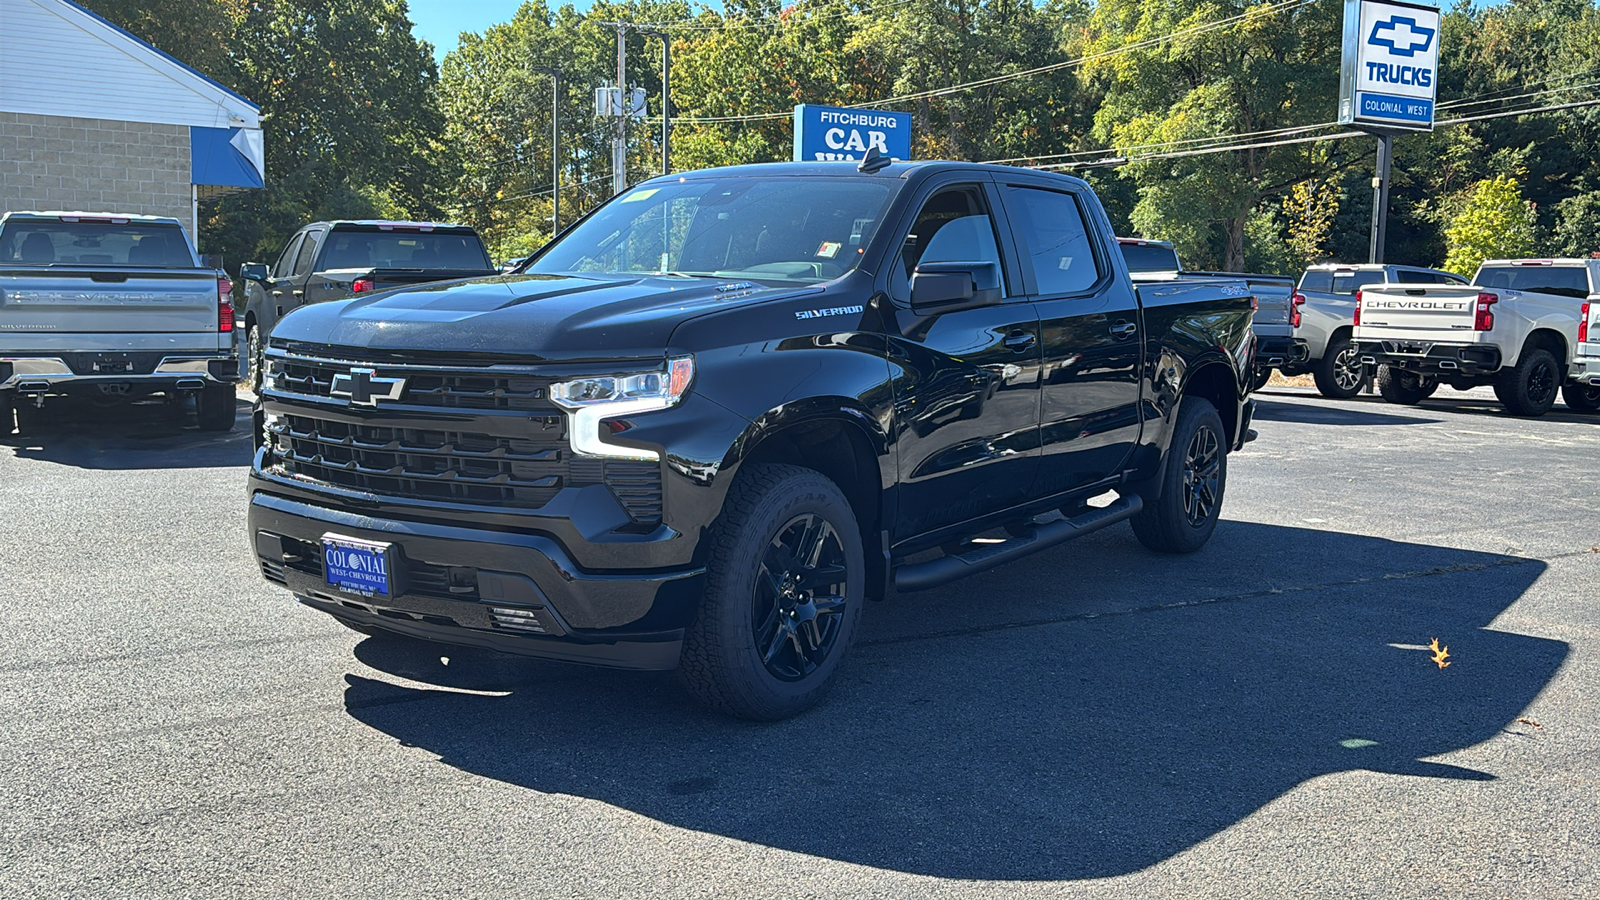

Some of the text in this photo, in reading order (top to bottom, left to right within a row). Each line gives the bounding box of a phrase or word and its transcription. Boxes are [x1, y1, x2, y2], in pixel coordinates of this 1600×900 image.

[1366, 61, 1431, 87] TRUCKS
[1365, 100, 1428, 116] COLONIAL WEST
[820, 111, 897, 128] FITCHBURG
[825, 127, 888, 153] CAR
[13, 291, 203, 302] CHEVROLET
[795, 305, 864, 320] SILVERADO
[1366, 301, 1467, 310] CHEVROLET
[326, 549, 387, 575] COLONIAL
[349, 571, 386, 584] CHEVROLET
